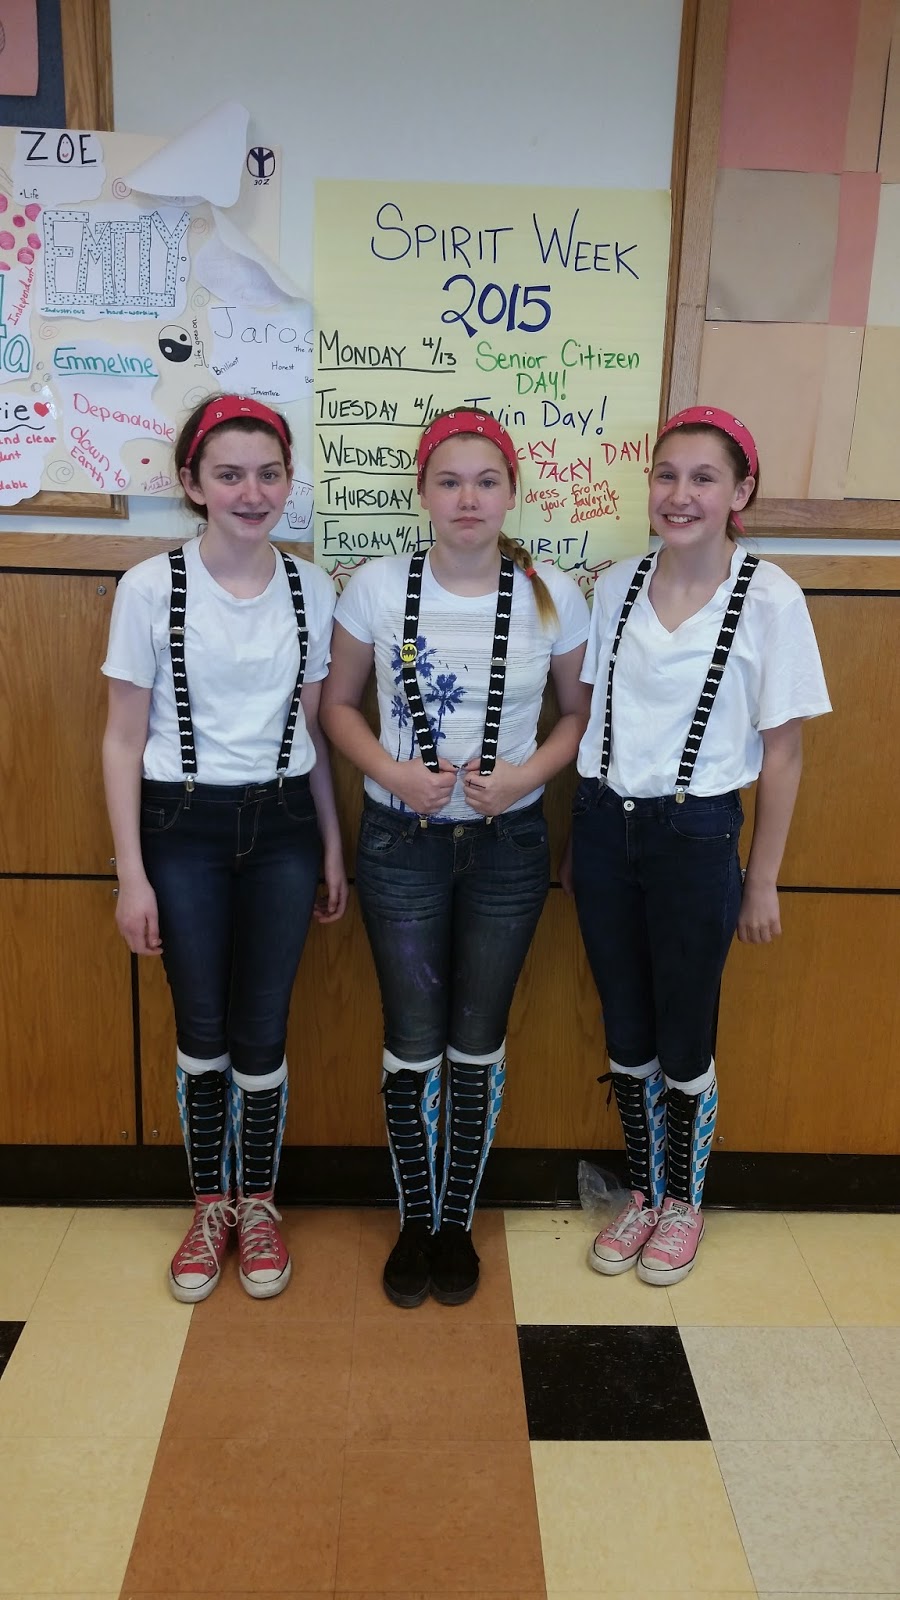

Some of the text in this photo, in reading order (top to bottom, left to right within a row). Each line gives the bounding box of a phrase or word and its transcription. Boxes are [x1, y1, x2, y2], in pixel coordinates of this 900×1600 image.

[20, 130, 97, 165] ZOE
[23, 188, 39, 200] Life
[370, 202, 640, 280] SPIRIT WEEK
[43, 210, 191, 308] EMILY
[440, 273, 551, 338] 2015
[53, 346, 159, 376] Emmeline
[271, 360, 295, 371] Honest
[318, 329, 641, 372] MONDAY 4/13 Senior Citizen
[516, 369, 568, 401] DAY!
[73, 392, 175, 442] Dependable
[315, 387, 398, 422] TUESDAY
[541, 395, 608, 436] Day!
[25, 433, 57, 444] clear
[319, 433, 557, 470] WEDNESD CKY
[601, 433, 651, 474] DAY!
[535, 457, 593, 484] TACKY
[320, 477, 414, 510] THURSDAY
[525, 479, 610, 504] dress from
[541, 497, 567, 523] your
[323, 520, 397, 555] FRIDAY
